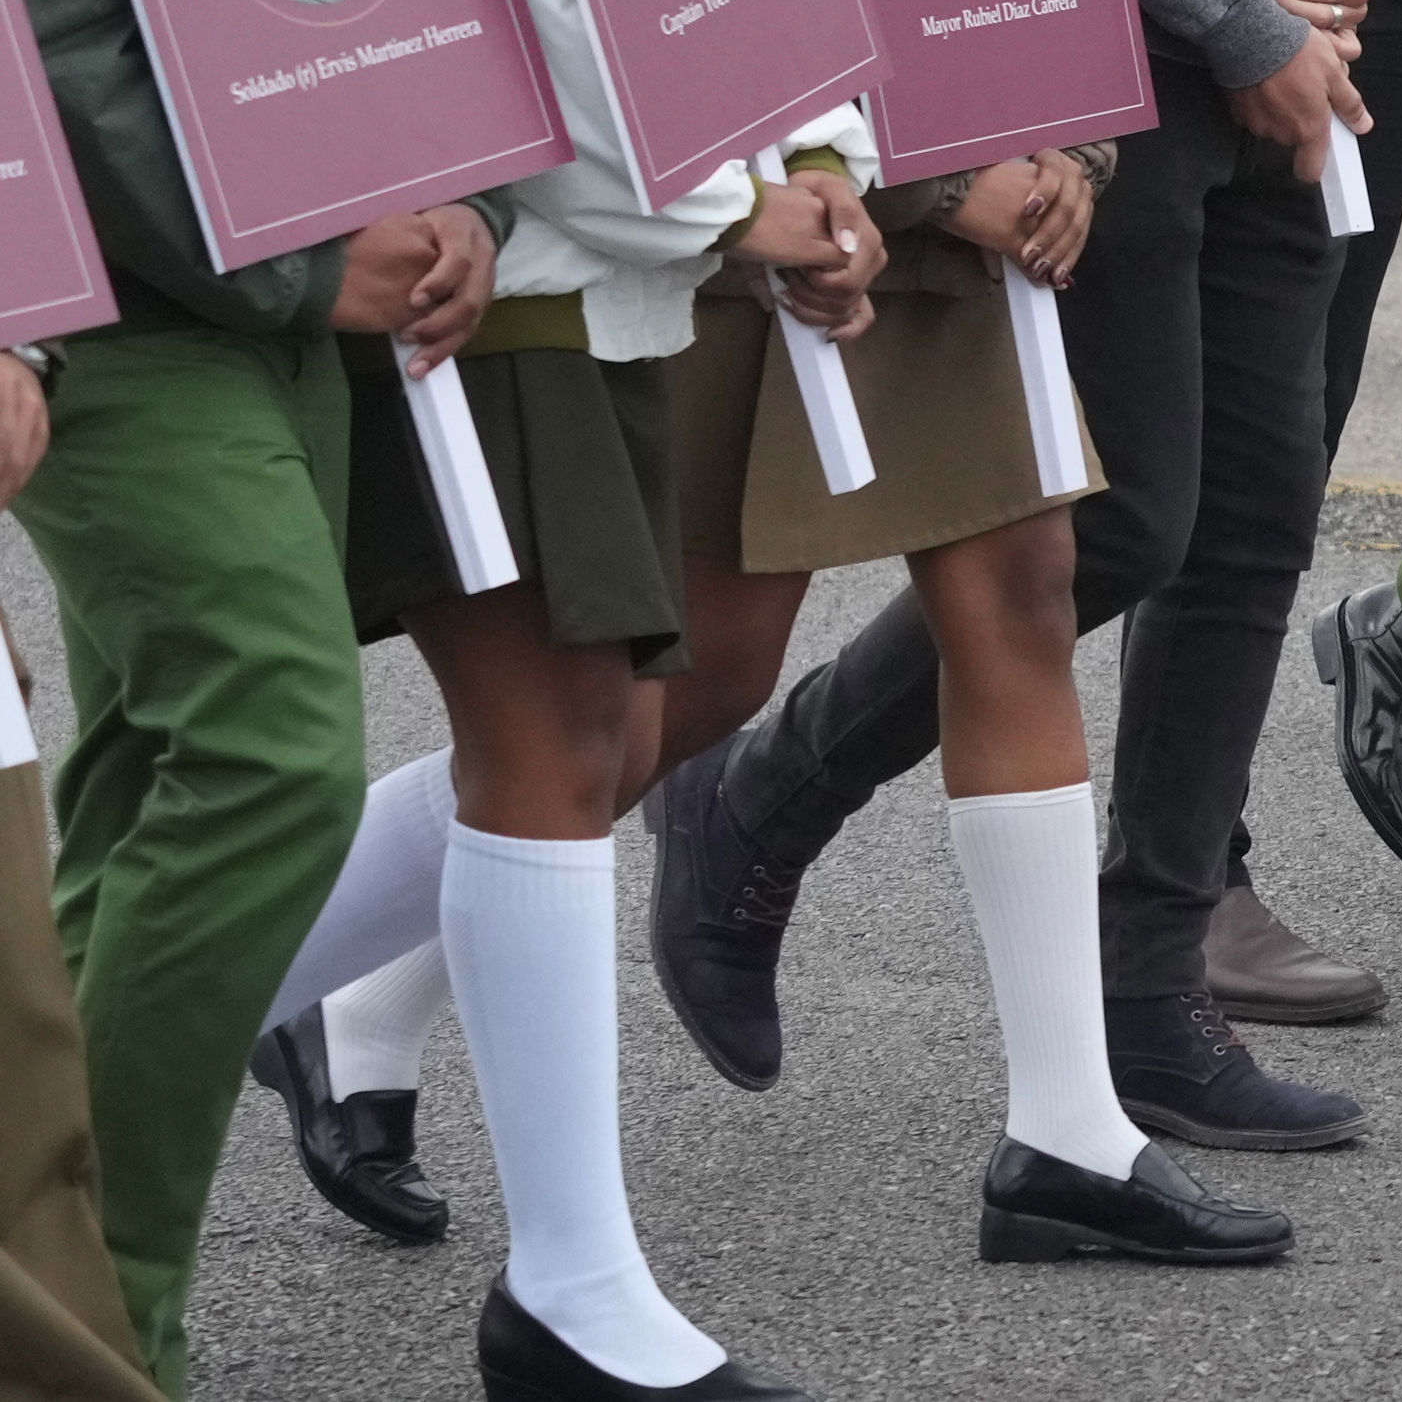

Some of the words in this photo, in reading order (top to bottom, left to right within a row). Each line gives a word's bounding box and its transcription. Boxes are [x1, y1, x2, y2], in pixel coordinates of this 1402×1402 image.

[660, 2, 705, 35] Capitán
[921, 15, 962, 40] Mayor
[962, 3, 1002, 29] Rubiel
[1002, 1, 1031, 22] Díaz
[229, 69, 296, 104] Soldado
[296, 63, 319, 91] (r)
[356, 38, 426, 68] Martínez
[422, 19, 483, 48] Herrera
